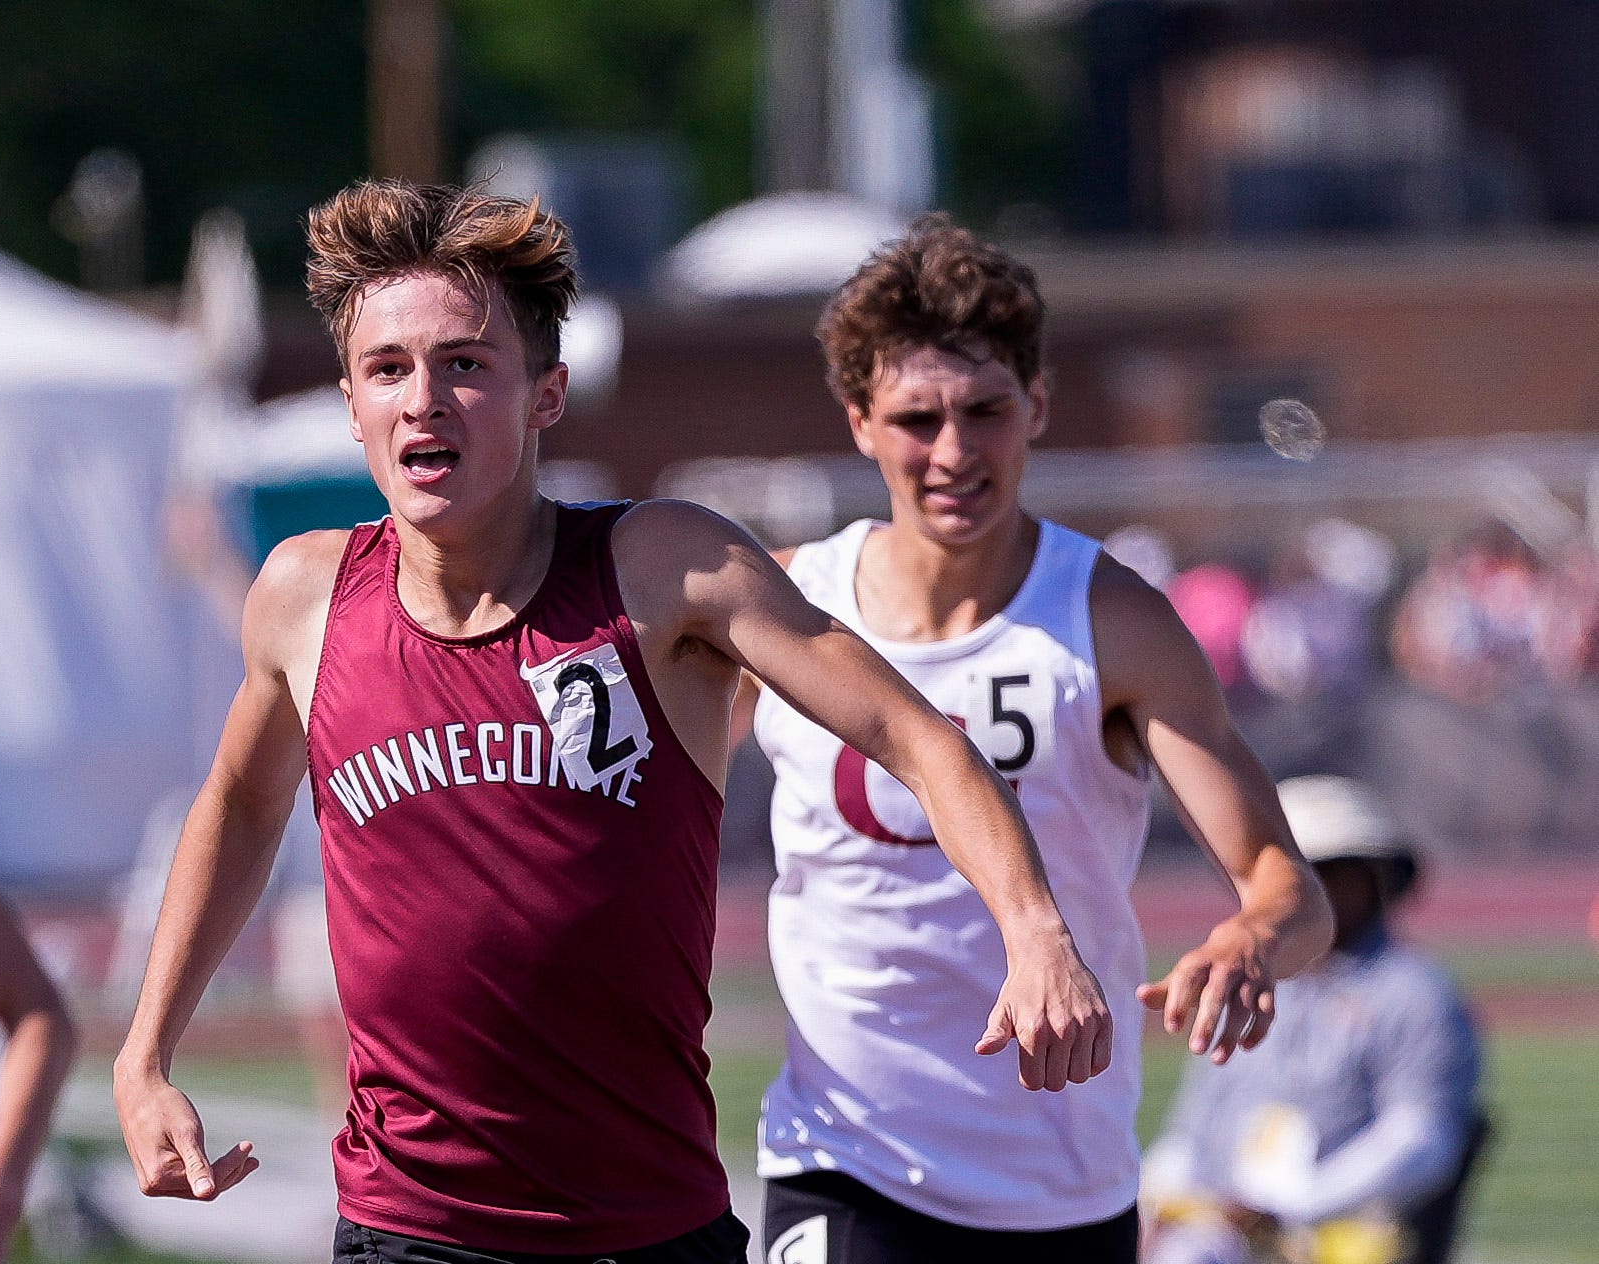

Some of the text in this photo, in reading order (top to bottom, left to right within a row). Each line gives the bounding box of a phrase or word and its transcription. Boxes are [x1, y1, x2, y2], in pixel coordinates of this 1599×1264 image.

[551, 662, 639, 775] 2
[990, 673, 1036, 771] 5
[327, 721, 649, 828] WINNECOE
